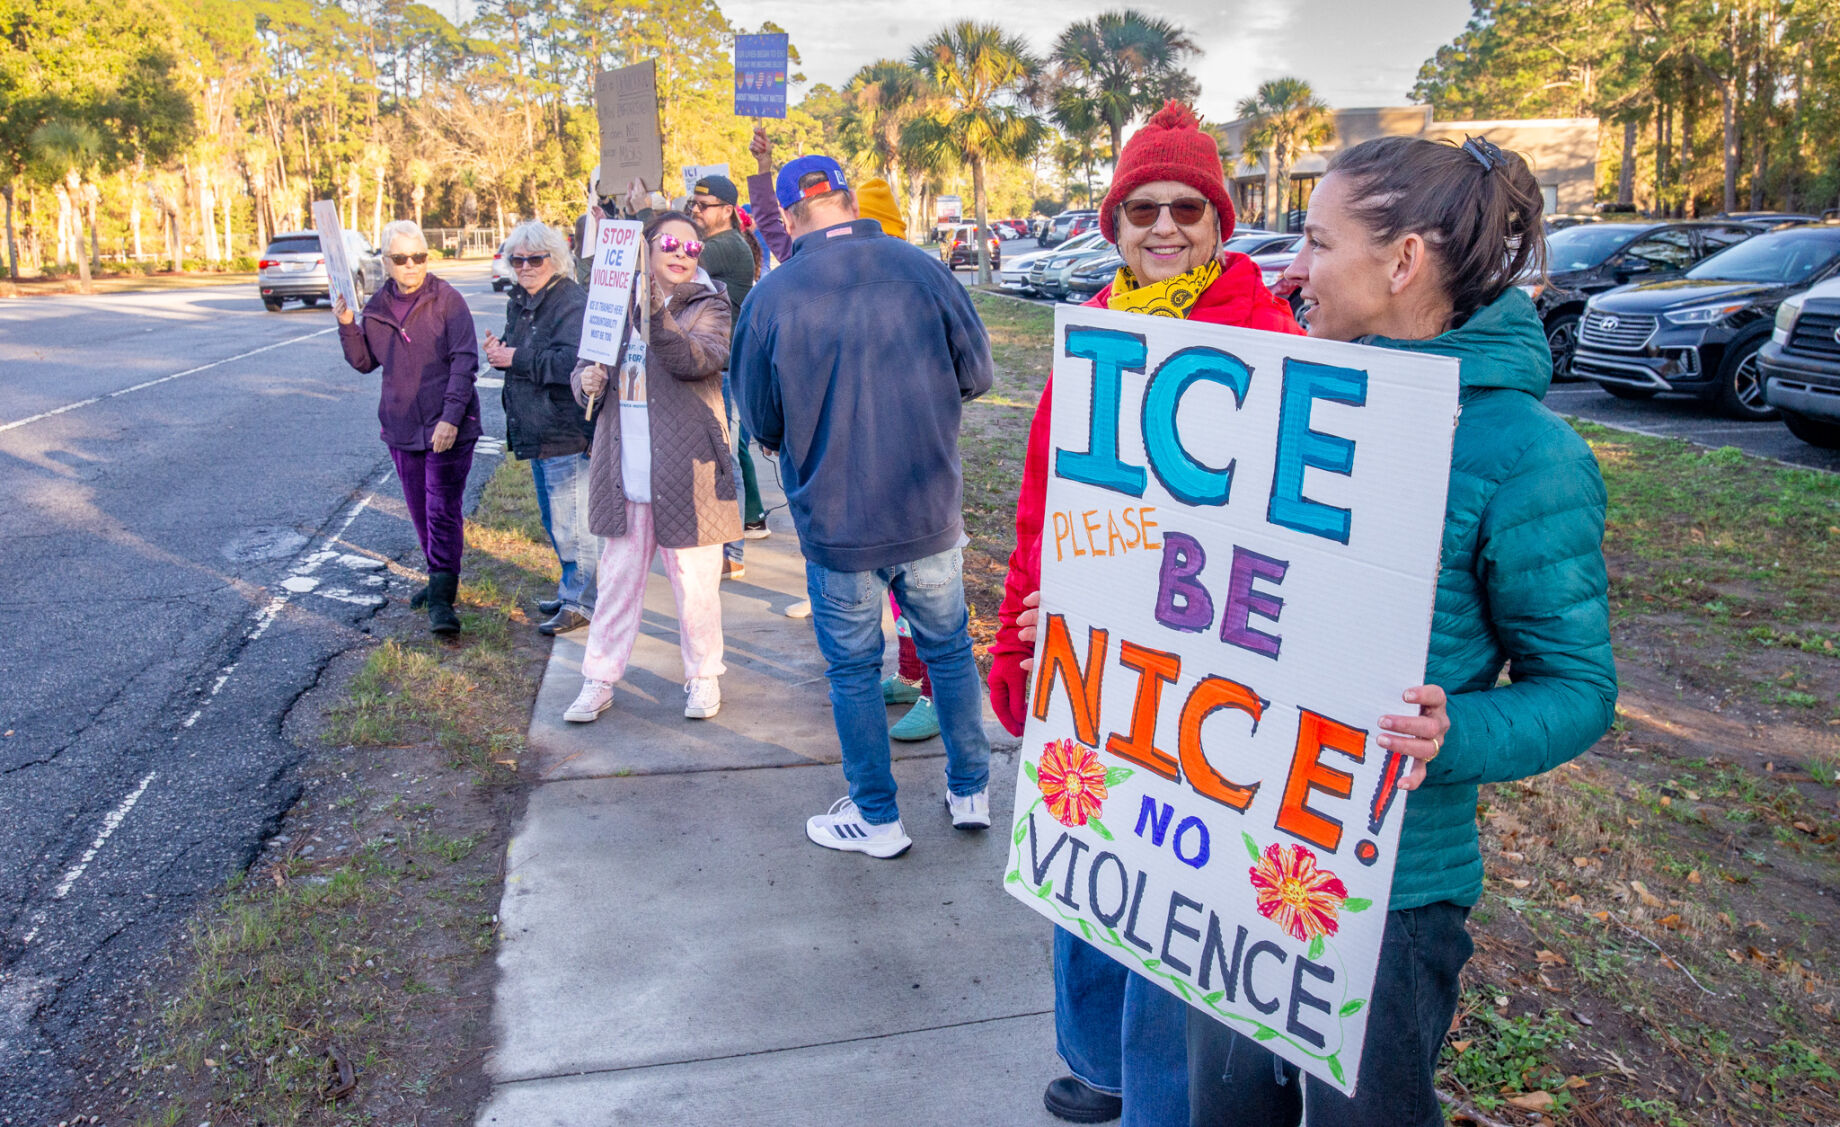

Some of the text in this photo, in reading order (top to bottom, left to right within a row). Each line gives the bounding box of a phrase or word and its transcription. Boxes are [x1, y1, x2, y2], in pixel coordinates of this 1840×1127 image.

[602, 227, 636, 246] STOP!
[604, 249, 624, 266] ICE
[593, 269, 630, 289] VIOLENCE
[628, 353, 642, 363] FOR
[1055, 324, 1368, 545] ICE
[1052, 507, 1289, 660] PLEASE BE
[1032, 612, 1408, 866] NICE!
[1134, 794, 1210, 869] NO
[1029, 813, 1335, 1049] VIOLENCE
